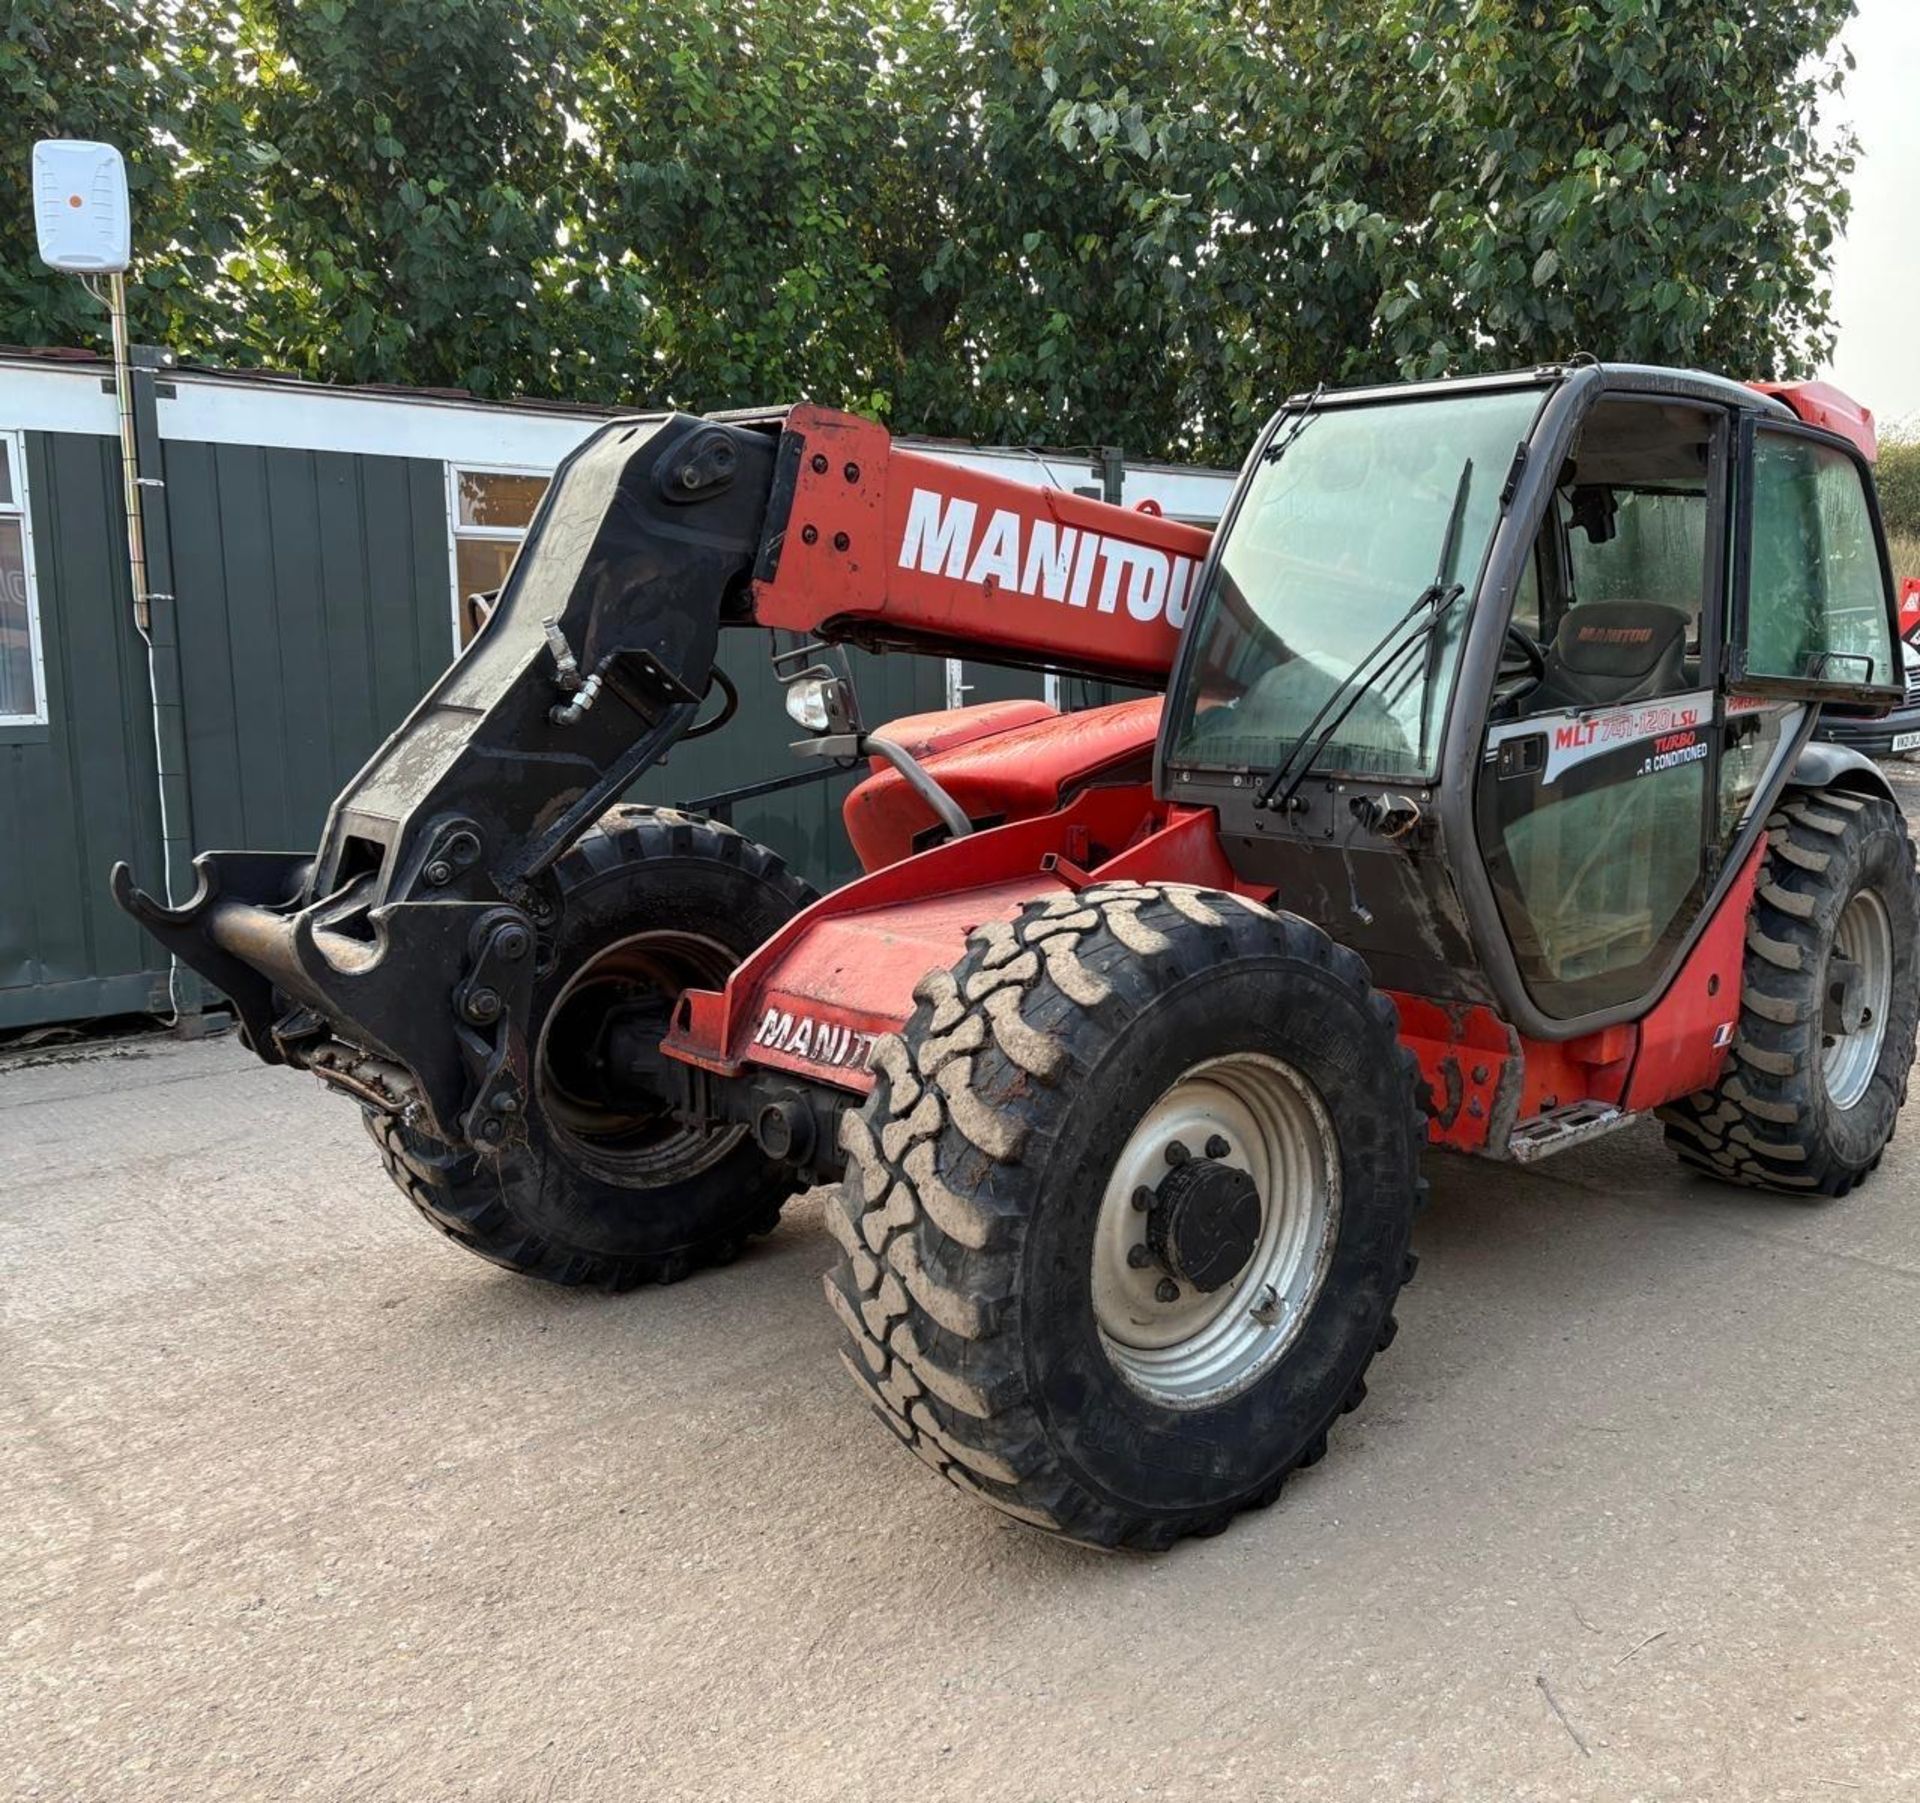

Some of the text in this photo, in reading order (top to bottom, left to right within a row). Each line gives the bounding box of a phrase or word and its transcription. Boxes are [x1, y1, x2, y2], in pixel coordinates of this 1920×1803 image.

[898, 487, 1201, 630] MANITOU
[1555, 719, 1599, 749] MLT
[1671, 709, 1698, 728] LSU
[1653, 731, 1696, 755] TURBO
[1653, 743, 1708, 771] CONDITIONED
[754, 1008, 880, 1072] MANIT
